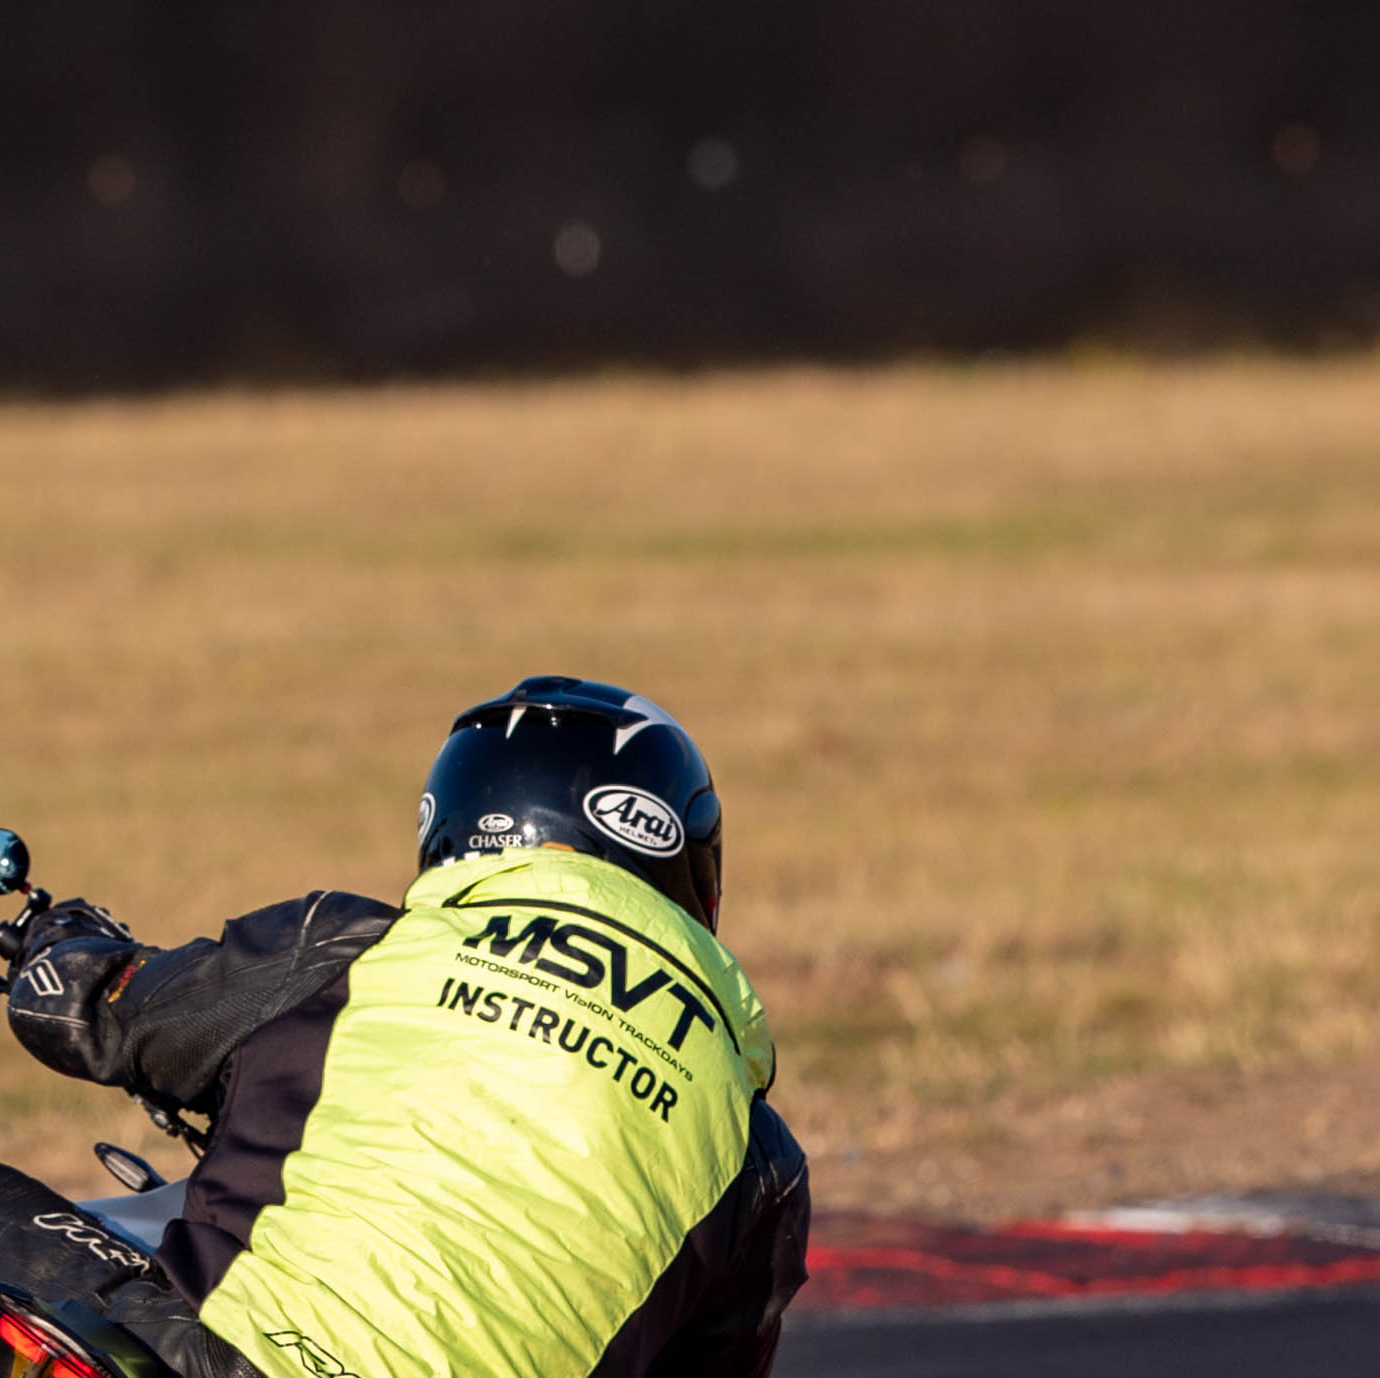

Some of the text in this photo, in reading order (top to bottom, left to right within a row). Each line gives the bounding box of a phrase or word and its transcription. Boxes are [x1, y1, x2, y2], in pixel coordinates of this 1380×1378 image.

[469, 834, 523, 848] CHASER
[595, 796, 674, 841] Arai
[455, 952, 695, 1083] MOTORSPORT VISION TRACKDAYS
[462, 915, 716, 1053] MSVT
[436, 977, 679, 1123] INSTRUCTOR
